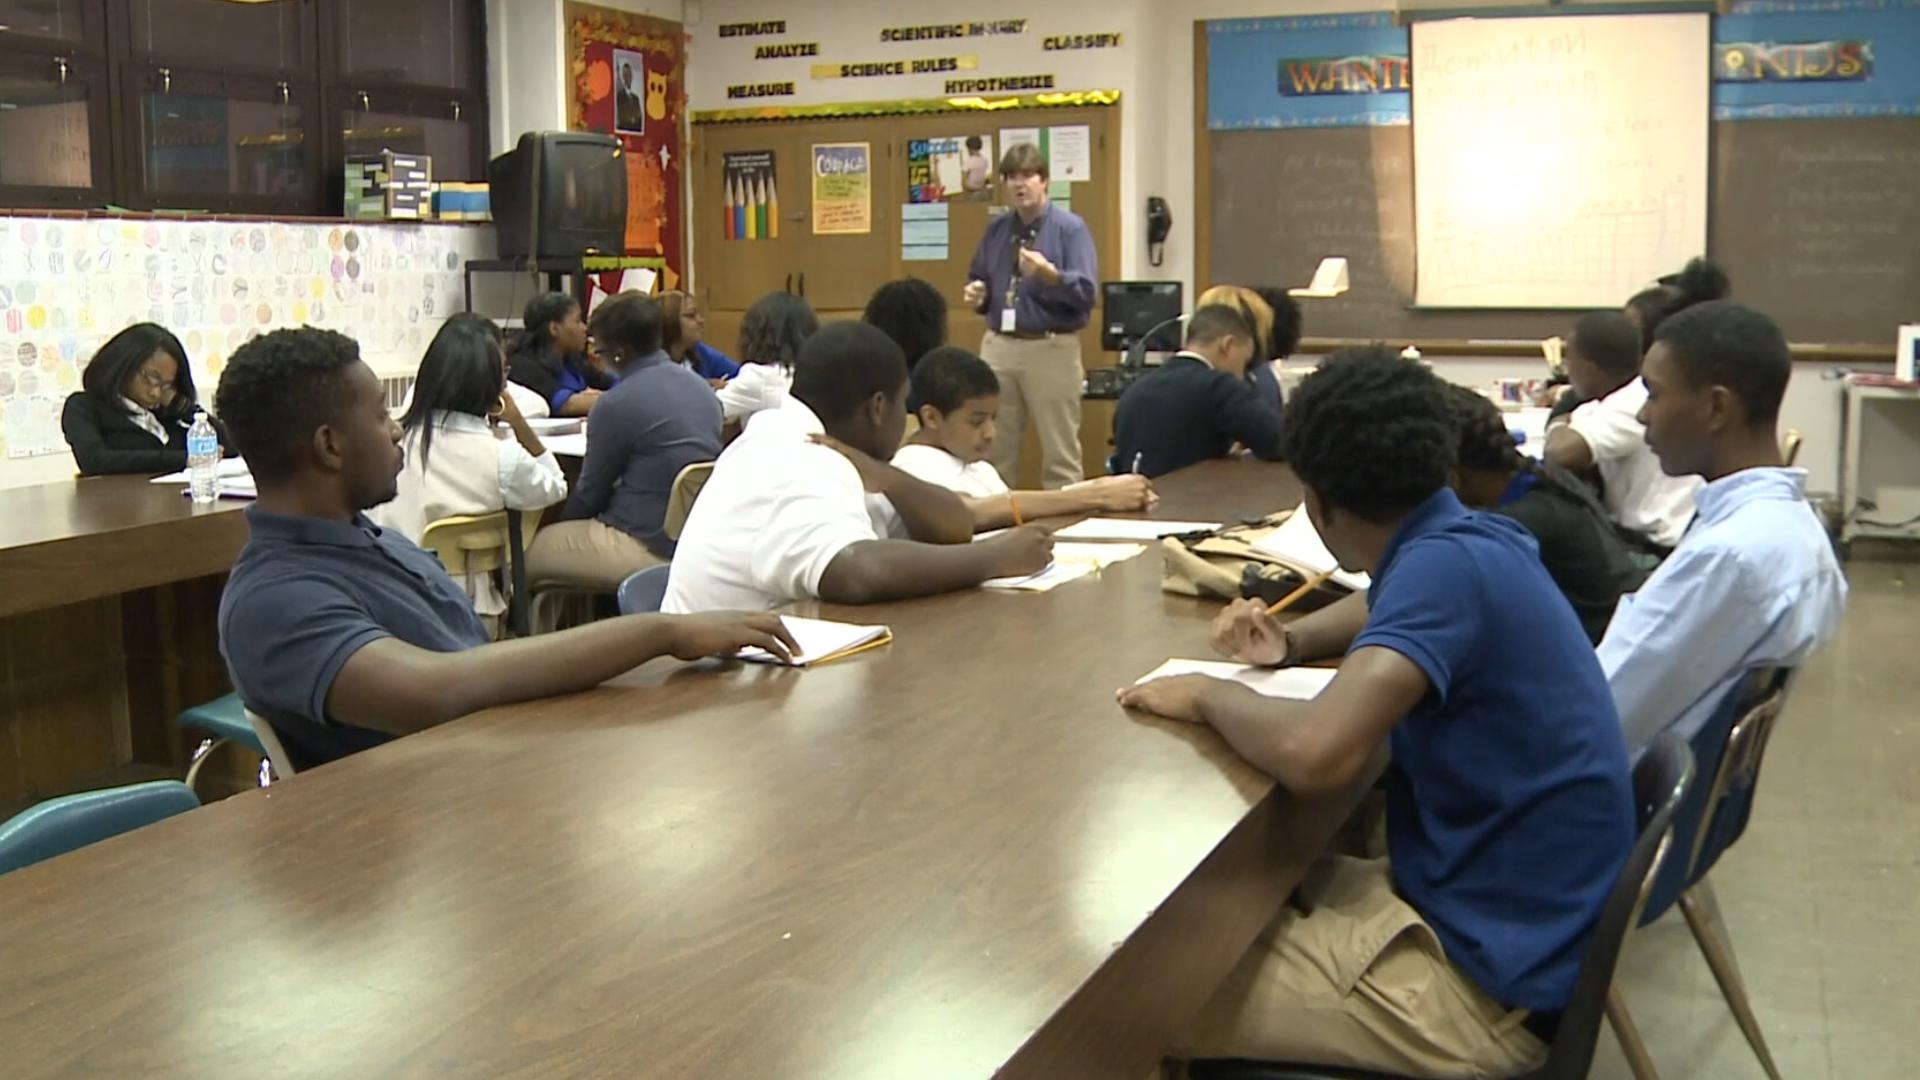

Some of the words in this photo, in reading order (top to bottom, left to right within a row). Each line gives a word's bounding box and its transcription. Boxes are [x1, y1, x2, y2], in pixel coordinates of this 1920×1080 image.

[719, 20, 786, 38] ESTIMATE
[881, 24, 963, 42] SCIENTIFIC
[1043, 33, 1120, 51] CLASSIFY
[755, 43, 818, 60] ANALYZE
[841, 61, 904, 77] SCIENCE
[911, 57, 958, 73] RULES
[727, 82, 795, 99] MEASURE
[945, 75, 1055, 94] HYPOTHESIZE
